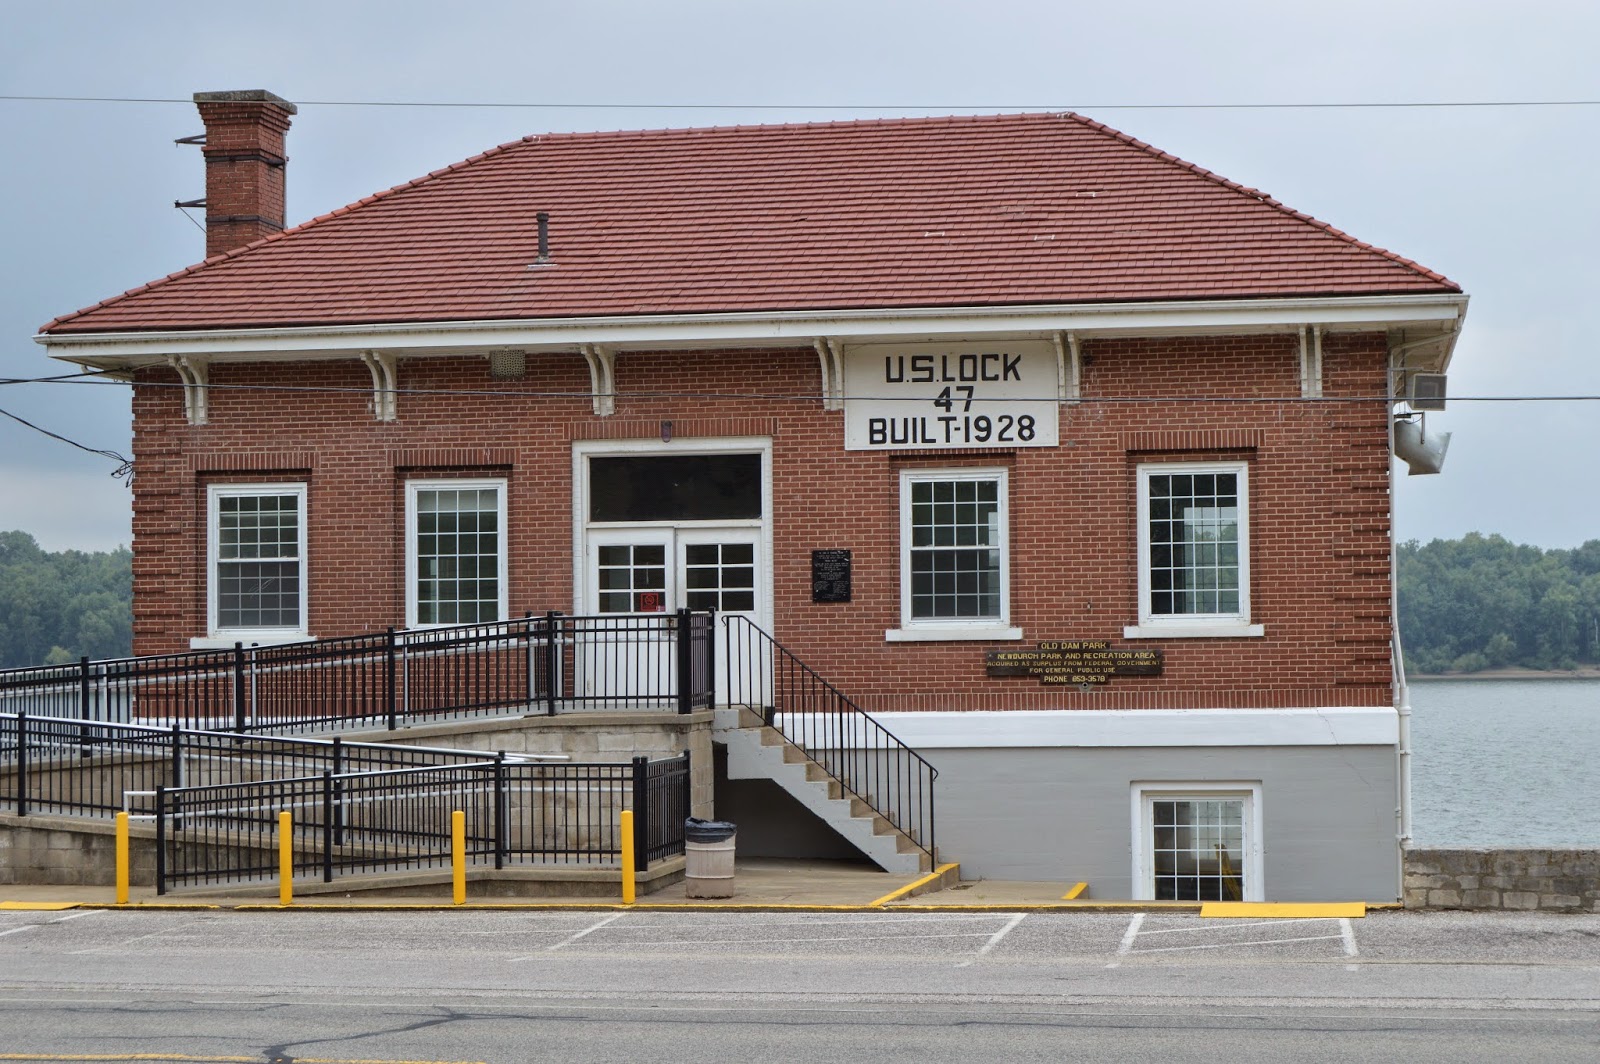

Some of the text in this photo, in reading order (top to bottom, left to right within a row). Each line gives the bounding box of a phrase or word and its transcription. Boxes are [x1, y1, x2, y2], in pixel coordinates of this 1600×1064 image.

[933, 386, 974, 413] 47
[869, 414, 1036, 445] BUILT-1928
[1041, 641, 1107, 650] OLD DAM PARK
